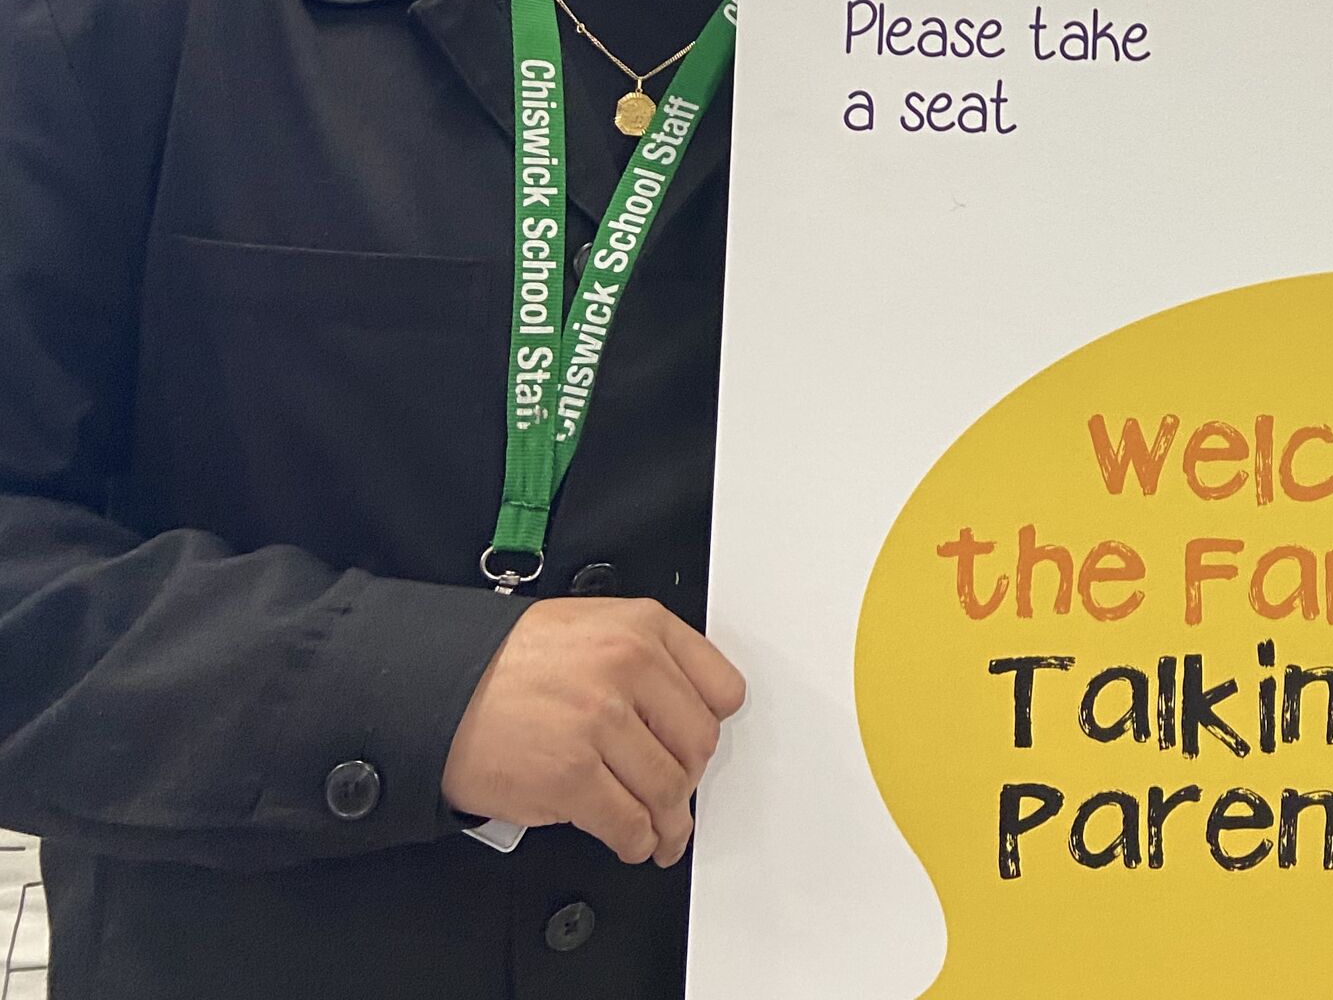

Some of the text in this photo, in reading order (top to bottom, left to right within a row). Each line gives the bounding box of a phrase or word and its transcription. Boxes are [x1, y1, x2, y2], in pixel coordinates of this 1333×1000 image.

[1028, 5, 1151, 62] take
[519, 58, 560, 207] Chiswick
[843, 79, 1018, 135] a seat
[593, 167, 666, 274] School
[642, 95, 700, 166] Staff
[518, 216, 559, 334] School
[933, 523, 1148, 624] the
